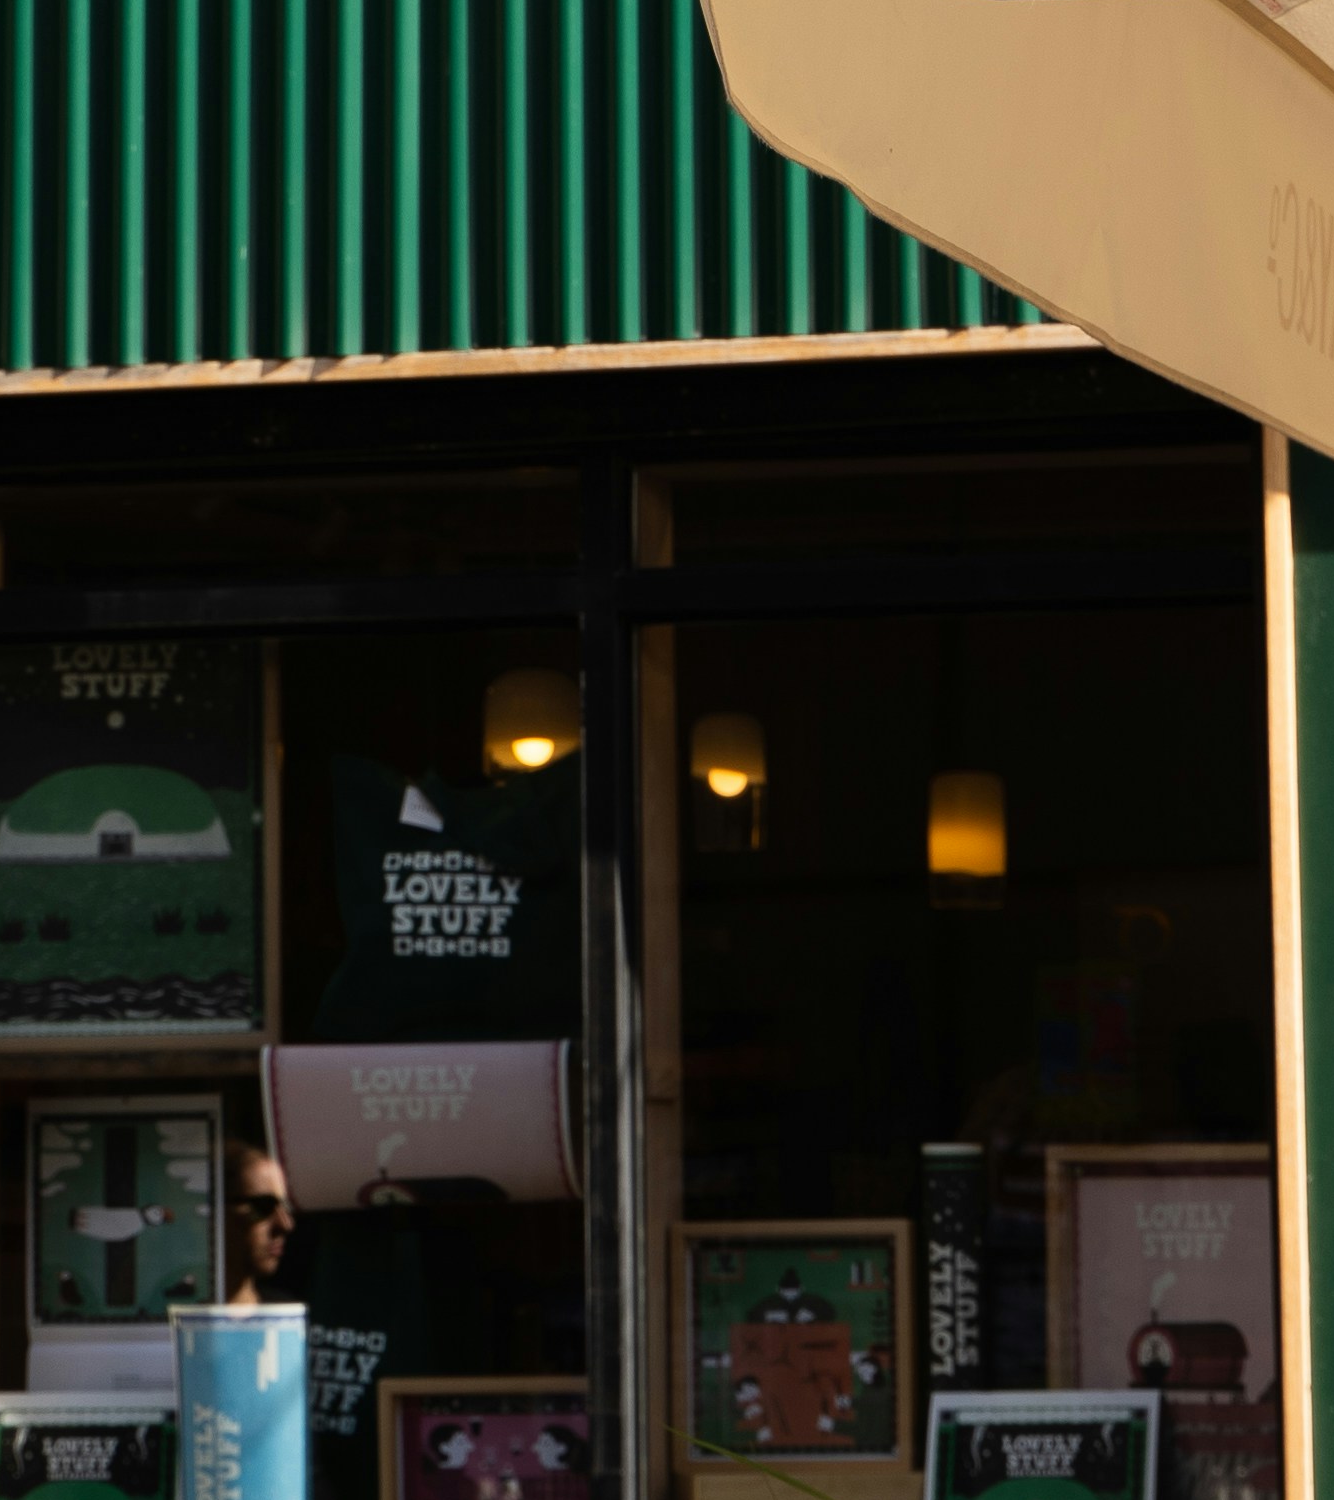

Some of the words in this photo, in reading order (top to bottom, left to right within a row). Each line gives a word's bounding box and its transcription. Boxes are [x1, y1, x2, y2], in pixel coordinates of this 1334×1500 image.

[52, 643, 179, 671] LOVELY
[61, 672, 169, 698] STUFF
[383, 873, 522, 904] LOVELY
[391, 904, 513, 935] STUFF
[350, 1064, 476, 1093] LOVELY
[361, 1095, 467, 1122] STUFF
[1134, 1201, 1235, 1230] LOVELY
[1142, 1232, 1225, 1259] STUFF
[928, 1240, 955, 1377] LOVELY
[955, 1250, 980, 1367] STUFF
